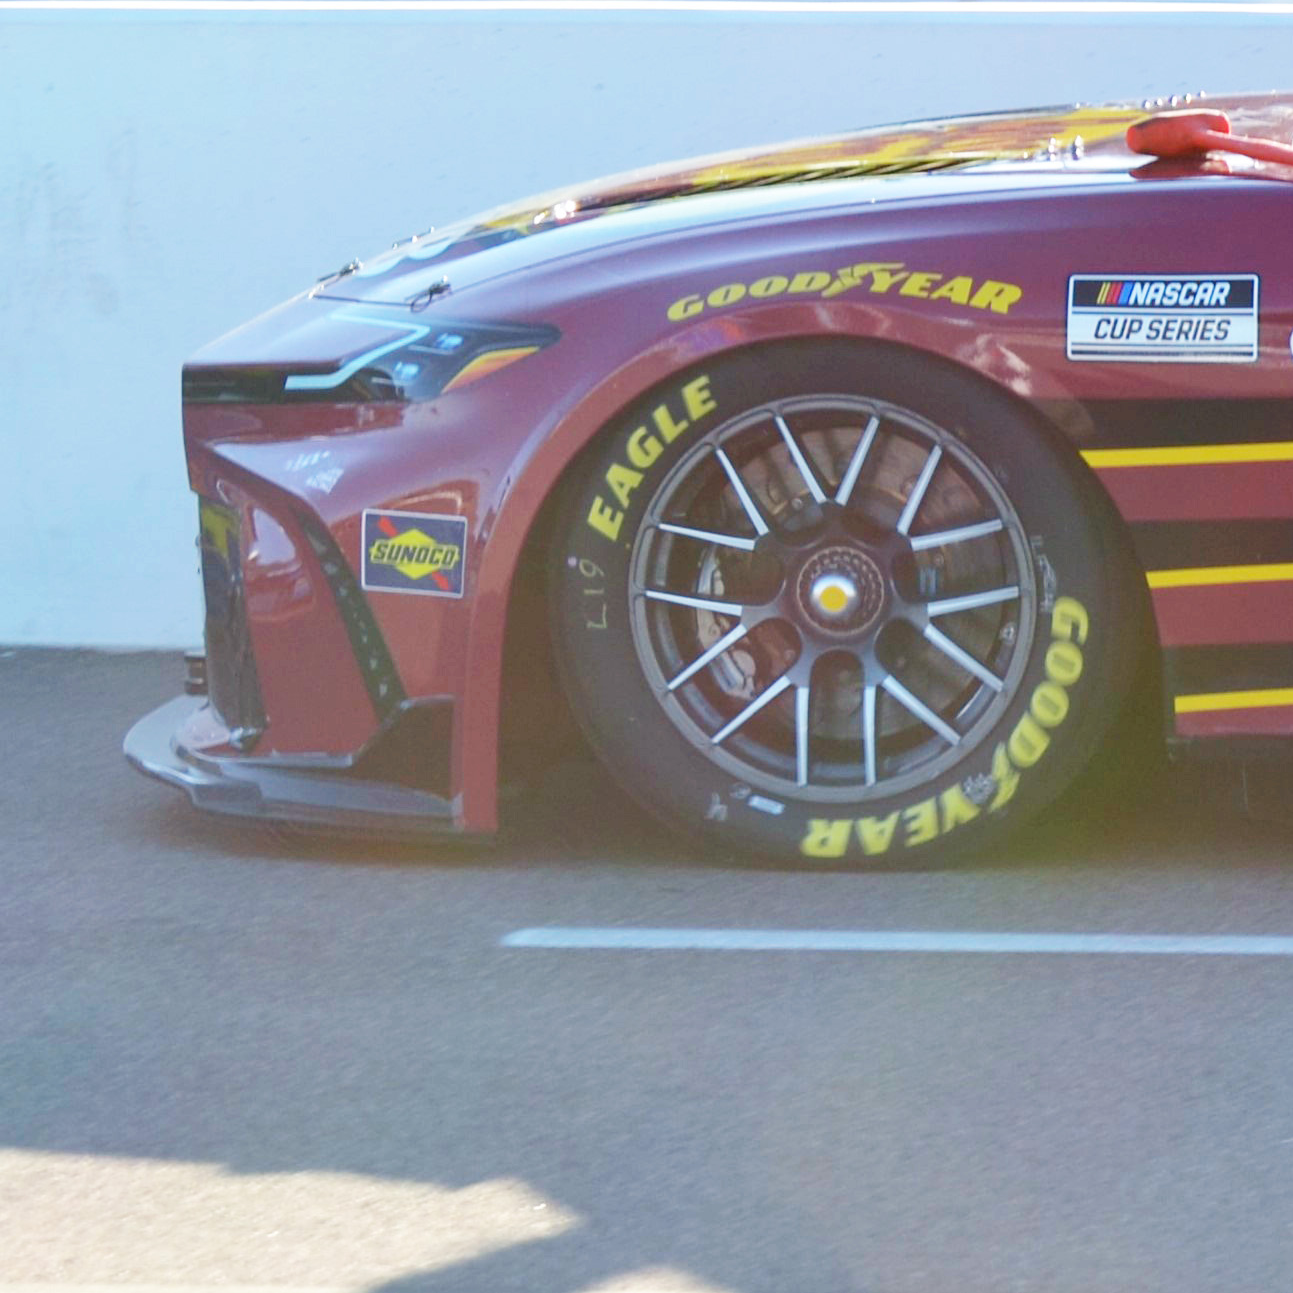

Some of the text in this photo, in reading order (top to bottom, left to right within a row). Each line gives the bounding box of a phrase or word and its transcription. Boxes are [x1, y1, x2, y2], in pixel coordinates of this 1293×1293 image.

[667, 261, 1022, 322] GOODYEAR
[1128, 281, 1231, 307] NASCAR
[1094, 318, 1231, 341] CUP SERIES
[587, 375, 718, 541] EAGLE
[372, 541, 457, 567] SUNOCO
